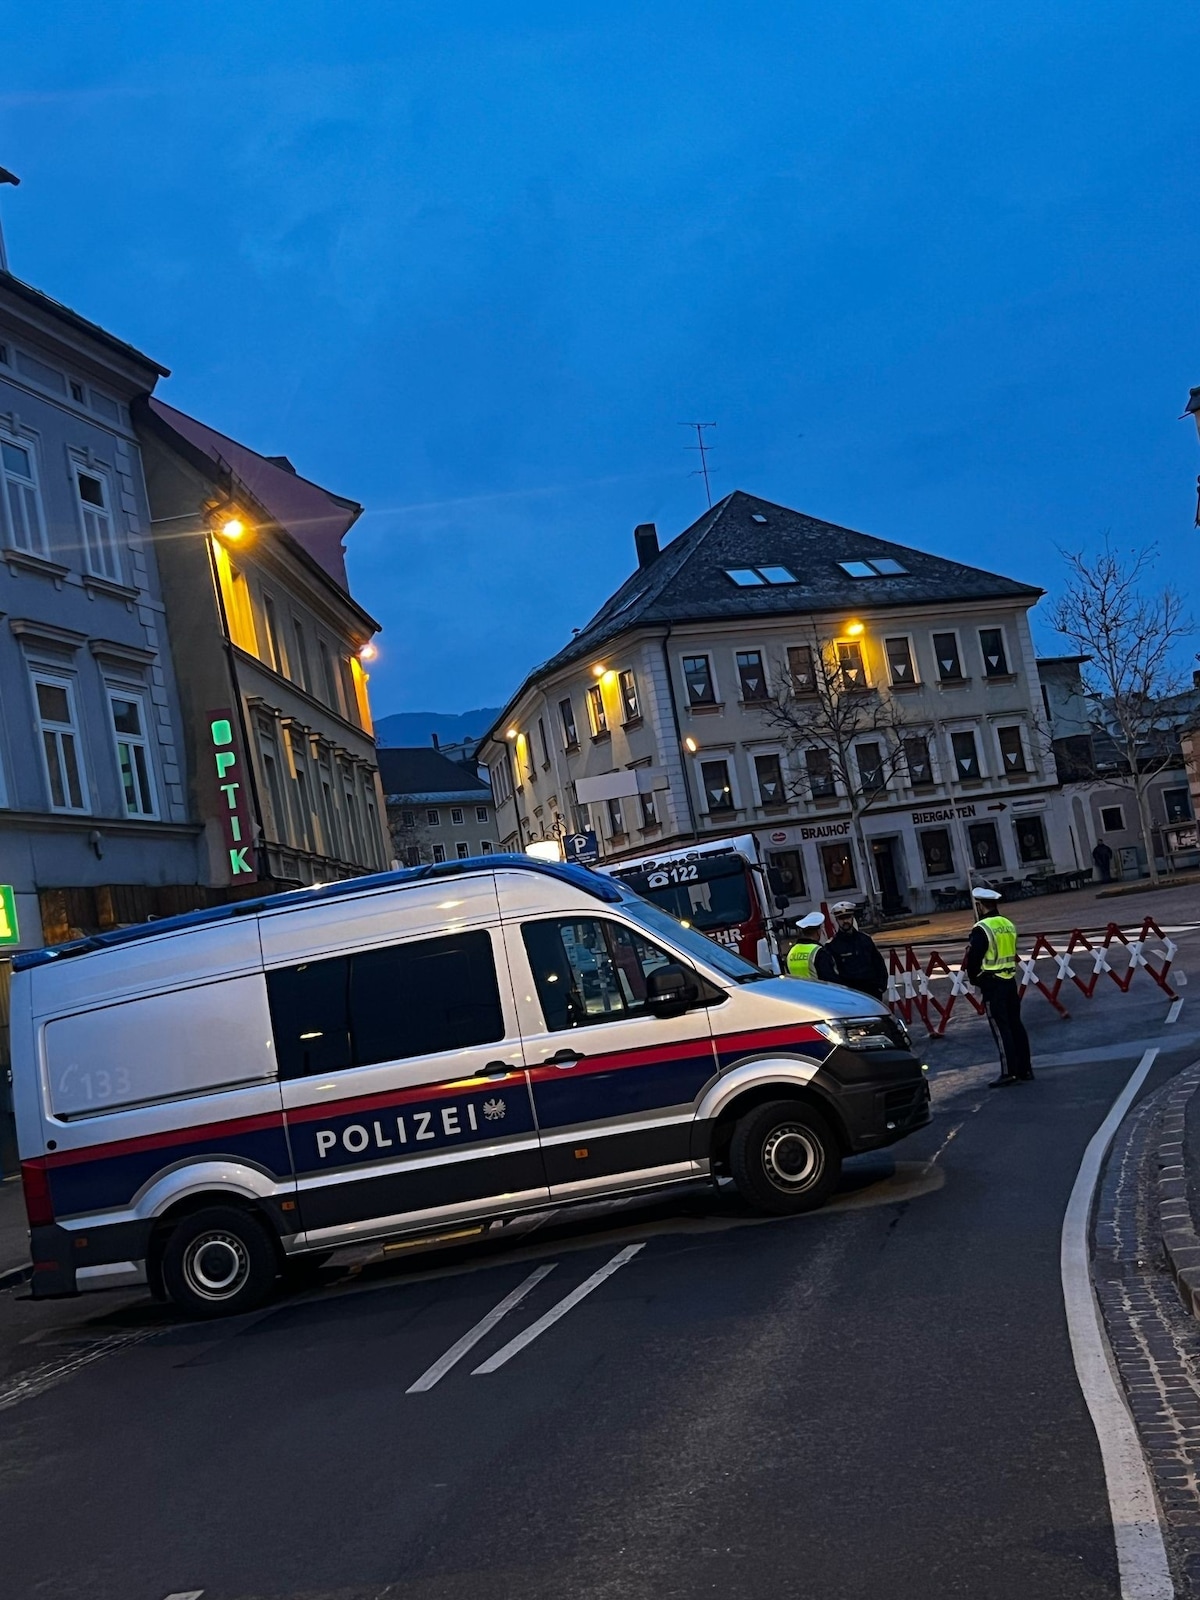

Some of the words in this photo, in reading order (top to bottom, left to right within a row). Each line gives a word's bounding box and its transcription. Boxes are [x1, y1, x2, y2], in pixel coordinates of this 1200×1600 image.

[211, 719, 252, 875] OPTIK
[912, 804, 976, 824] BIERGARTEN
[801, 822, 850, 839] BRAUHOF
[574, 837, 587, 853] P
[671, 865, 698, 882] 122
[81, 1067, 131, 1100] 133
[316, 1103, 478, 1158] POLIZEI
